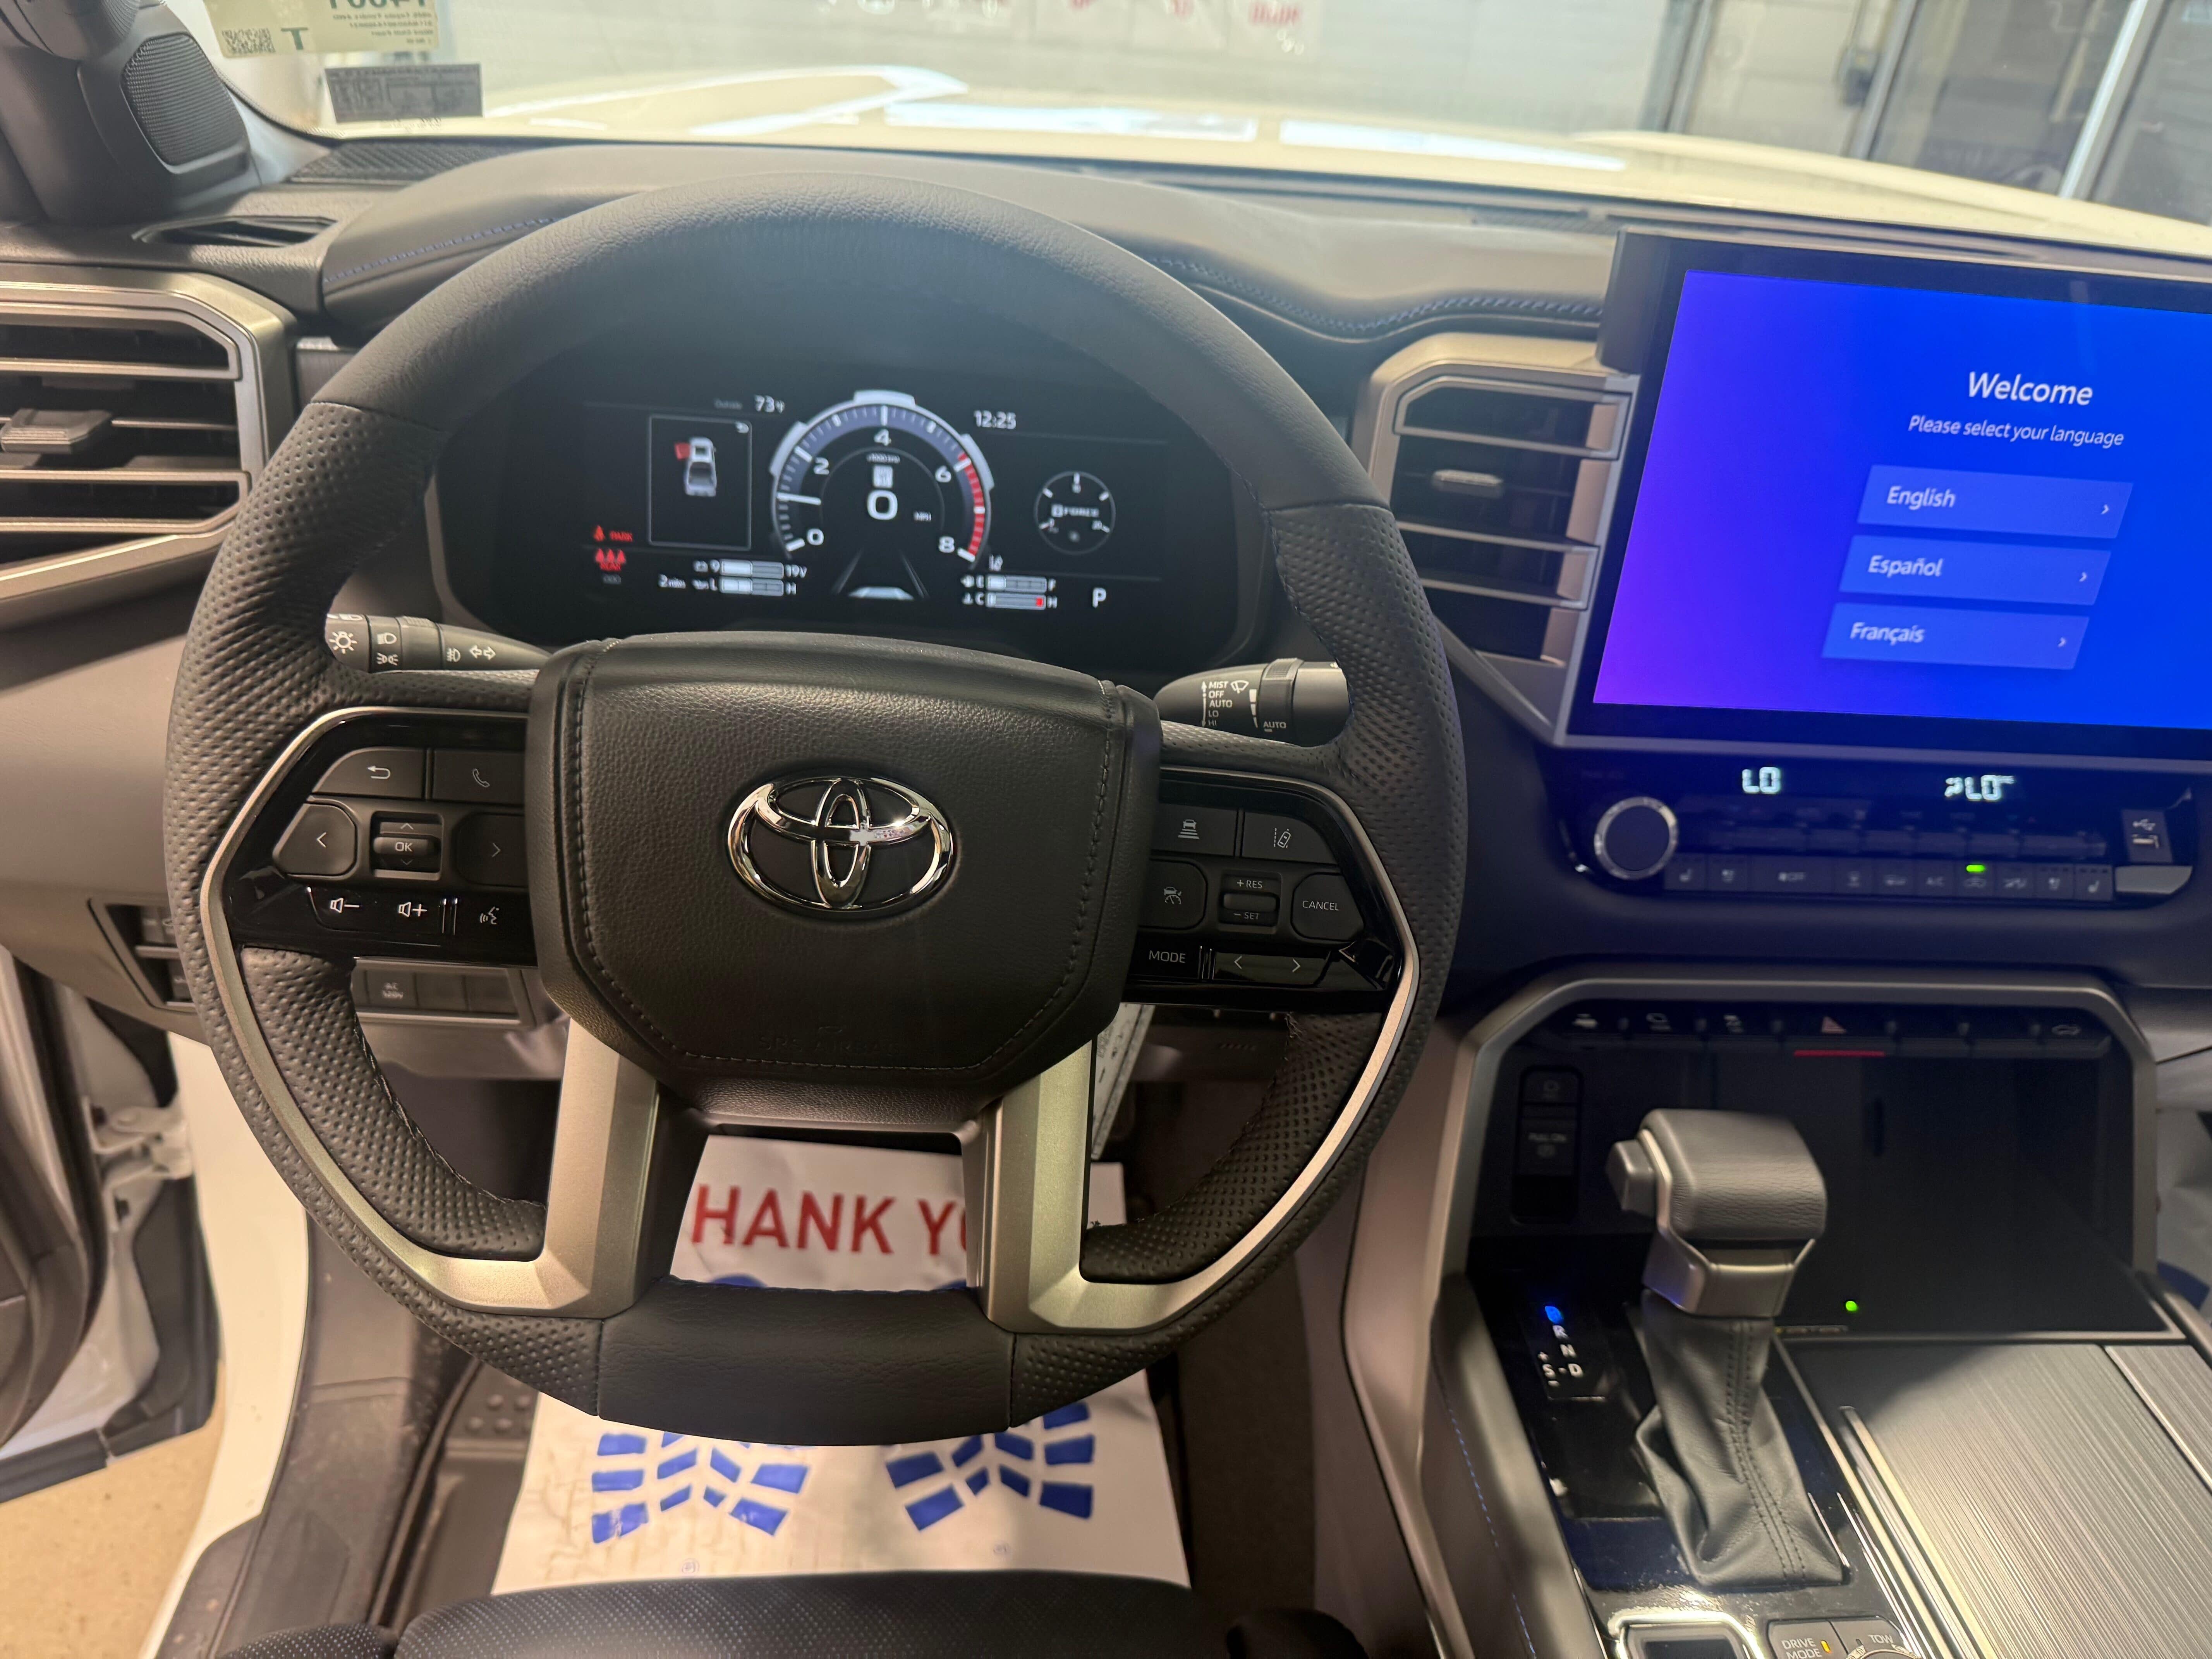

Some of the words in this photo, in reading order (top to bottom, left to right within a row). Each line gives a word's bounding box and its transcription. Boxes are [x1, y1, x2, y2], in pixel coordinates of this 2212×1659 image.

[1968, 371, 2093, 405] Welcome
[974, 410, 1017, 429] 12:25
[874, 429, 891, 446] 4
[1908, 415, 1961, 434] Please
[1963, 420, 2010, 438] select
[2010, 426, 2048, 442] your
[2050, 425, 2124, 449] language
[814, 457, 830, 475] 2
[935, 466, 951, 483] 6
[867, 489, 898, 520] 0
[1886, 486, 1956, 510] English
[806, 528, 824, 546] 0
[938, 536, 955, 553] 8
[1867, 555, 1943, 577] Español
[975, 592, 985, 605] C
[1092, 587, 1106, 608] P
[1850, 622, 1926, 646] Français
[1209, 700, 1233, 708] AUTO
[1742, 766, 1781, 794] LO
[395, 842, 413, 852] OK
[1246, 880, 1263, 889] RES
[1302, 900, 1340, 911] CANCEL
[1149, 950, 1186, 963] MODE
[917, 1199, 965, 1255] Y
[1553, 1325, 1568, 1339] R
[1560, 1344, 1577, 1358] N
[1542, 1364, 1556, 1378] S
[1568, 1363, 1583, 1377] D
[1782, 1638, 1816, 1650] DRIVE
[1869, 1634, 1894, 1644] TOW
[1786, 1648, 1822, 1659] MODE
